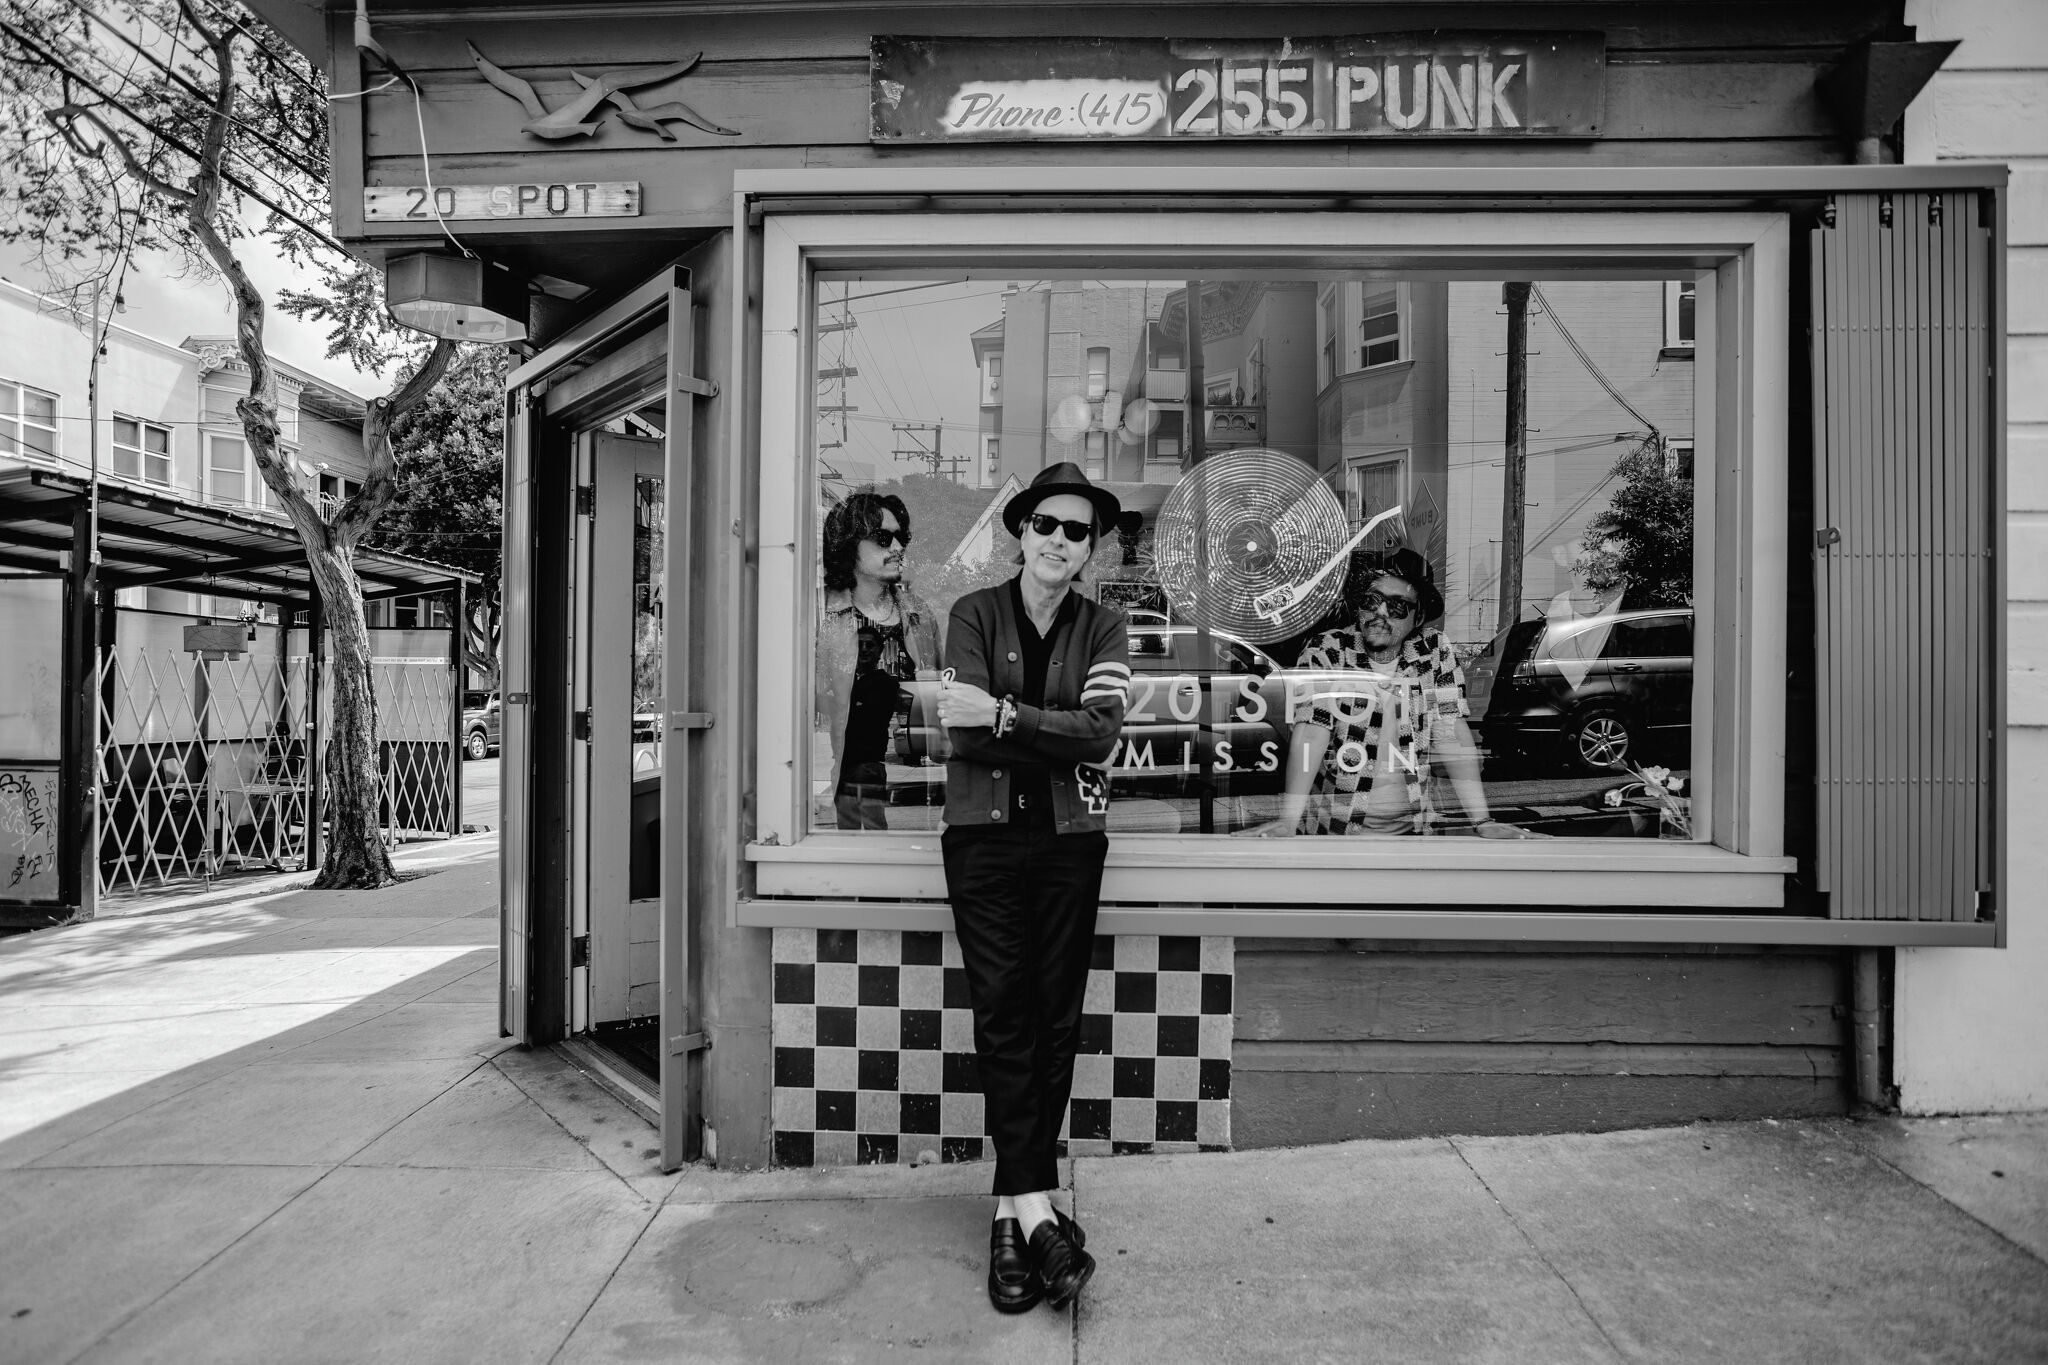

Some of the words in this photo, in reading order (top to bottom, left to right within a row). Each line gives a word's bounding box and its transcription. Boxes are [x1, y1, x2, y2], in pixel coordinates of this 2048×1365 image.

[406, 187, 456, 218] 20
[490, 184, 597, 217] SPOT
[1123, 673, 1202, 722] 20
[1235, 673, 1421, 724] SPOT
[1123, 739, 1416, 776] MISSION
